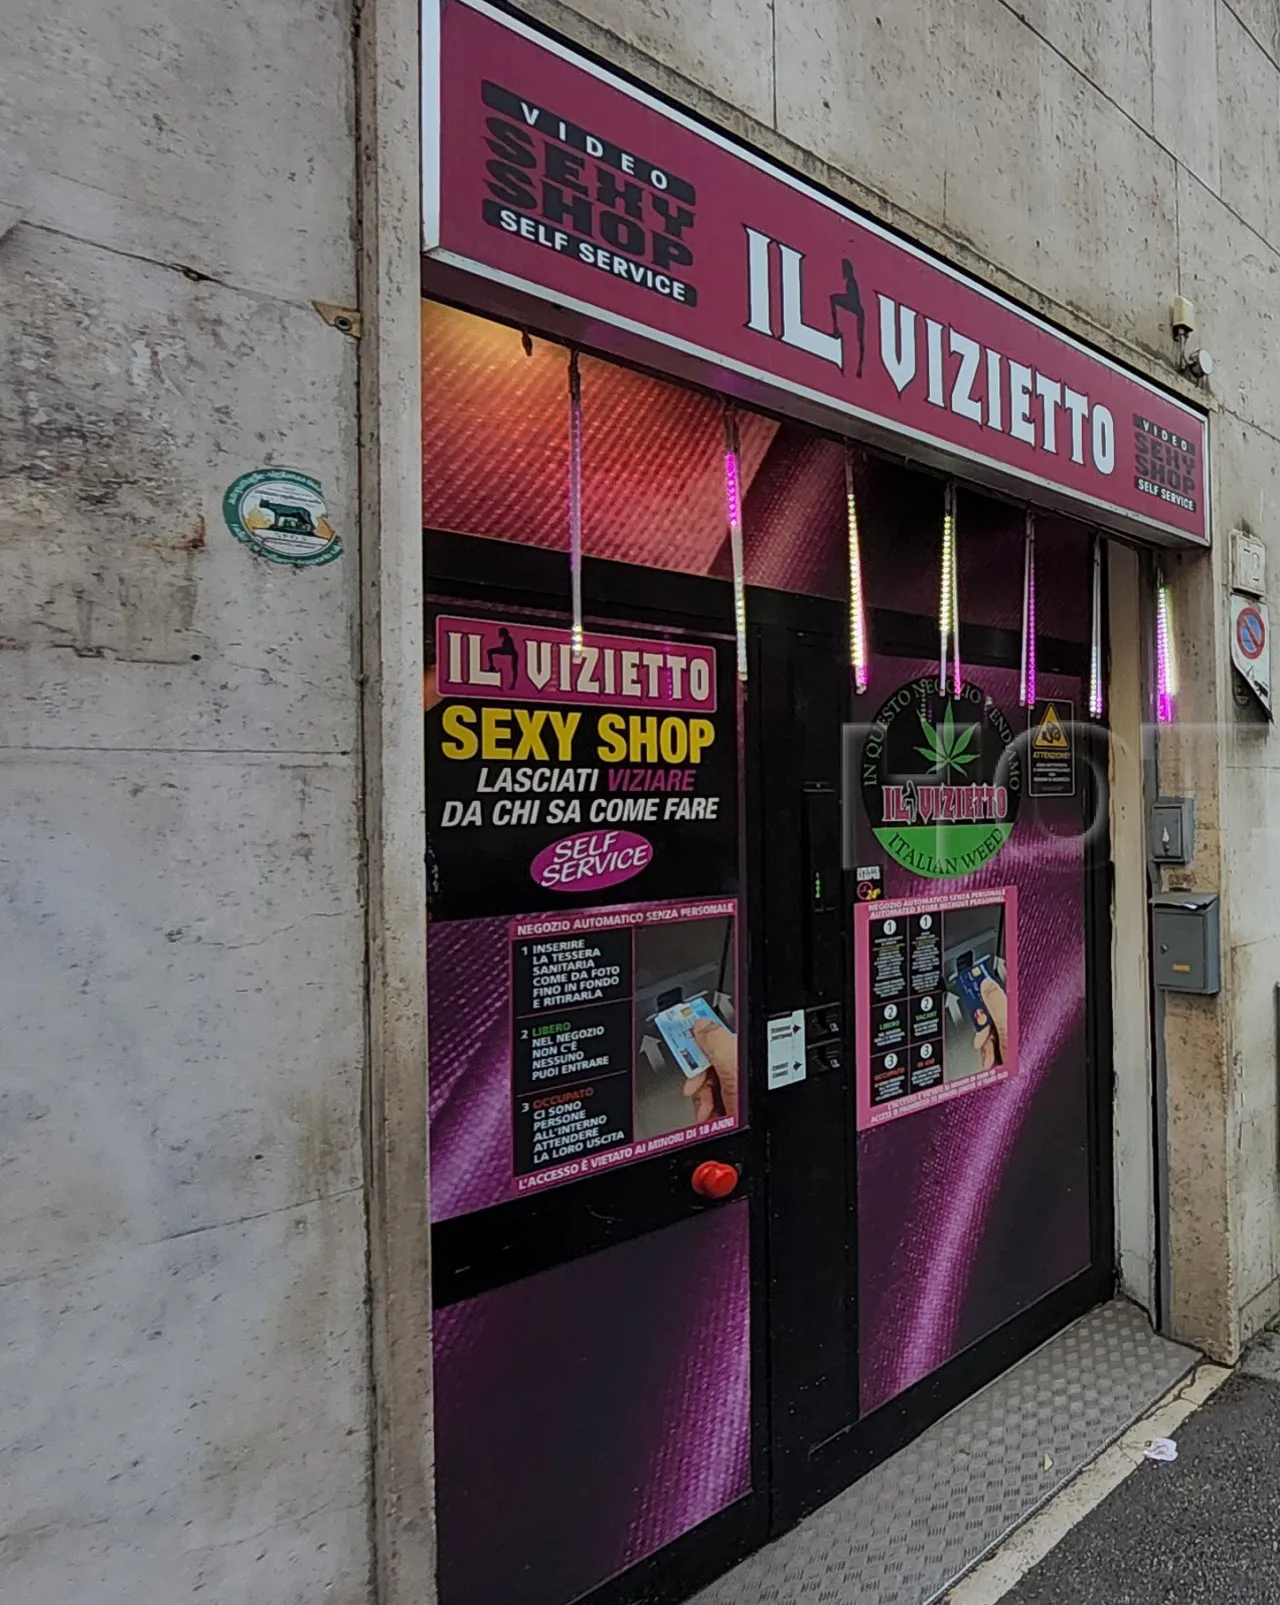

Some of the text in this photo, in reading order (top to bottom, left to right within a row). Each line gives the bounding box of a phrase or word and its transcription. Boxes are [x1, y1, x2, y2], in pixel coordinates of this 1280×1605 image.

[521, 102, 668, 190] VIDEO
[481, 116, 697, 241] SEXY
[482, 158, 694, 271] SHOP
[500, 208, 686, 302] SELF SERVICE
[742, 222, 1116, 476] IL VIZIETTO
[1142, 419, 1188, 451] VIDEO
[1134, 431, 1196, 475] SEXY
[1134, 454, 1195, 494] SHOP
[1138, 478, 1195, 511] SELF SERVICE
[447, 631, 710, 702] IL VIZIETTO
[441, 704, 716, 764] SEXY SHOP
[866, 690, 911, 759] QUESTO
[984, 701, 1020, 791] ENDAMO
[476, 767, 697, 793] LASCIATI VIZIARE
[863, 763, 878, 786] IN
[440, 796, 720, 827] DA CHI SA COME FARE
[881, 783, 1008, 825] IL VIZIETTO
[553, 831, 620, 864] SELF
[888, 828, 1004, 875] ITALIAN WEED
[539, 844, 650, 888] SERVICE
[517, 902, 735, 936] NEGOZIO AUTOMATICO SENZA PERSONALE
[521, 938, 586, 955] 1 INSERIRE
[532, 947, 601, 965] LA TESSERA
[532, 959, 596, 976] SANITARIA
[532, 965, 621, 987] COME DA FOTO
[532, 976, 620, 999] FINO IN FONDO
[532, 989, 604, 1009] E RITIRARLA
[521, 1021, 572, 1039] 2 LIBERO
[532, 1025, 605, 1048] NEL NEGOZIO
[532, 1046, 558, 1059] NON
[532, 1051, 585, 1070] NESSUNO
[532, 1055, 610, 1081] PUOI ENTRARE
[521, 1087, 596, 1112] 3 OCCUPATO
[533, 1100, 582, 1120] CI SONO
[533, 1109, 587, 1132] PERSONE
[533, 1114, 608, 1142] ALL'INTERNO
[518, 1117, 735, 1190] L'ACCESSO È VIETATO AI MINORI DI 18 ANNI
[533, 1127, 600, 1153] ATTENDERE
[533, 1130, 625, 1164] LA LORO USCITA
